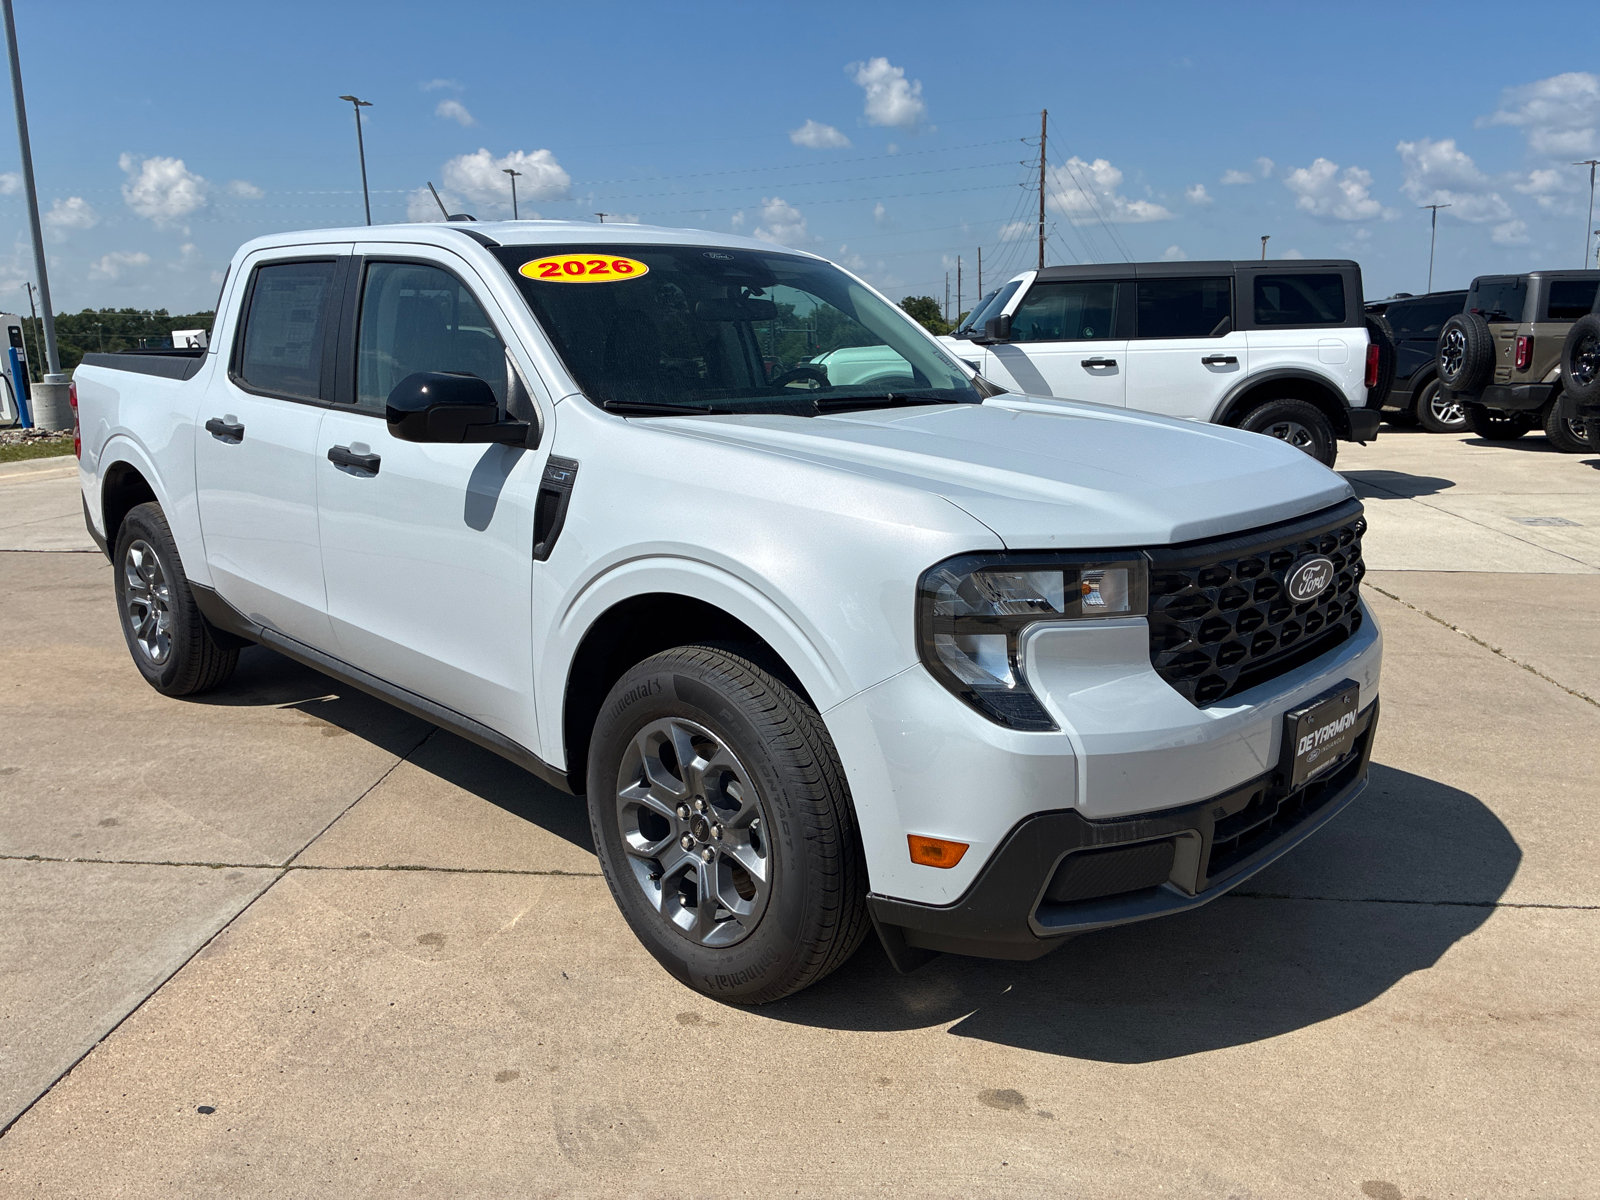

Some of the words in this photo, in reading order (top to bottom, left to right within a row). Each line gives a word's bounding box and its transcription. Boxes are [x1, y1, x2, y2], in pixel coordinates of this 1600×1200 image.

[538, 259, 636, 278] 2026
[546, 468, 570, 481] XLT
[1298, 564, 1327, 596] Ford
[1297, 708, 1357, 757] DEYARMAN
